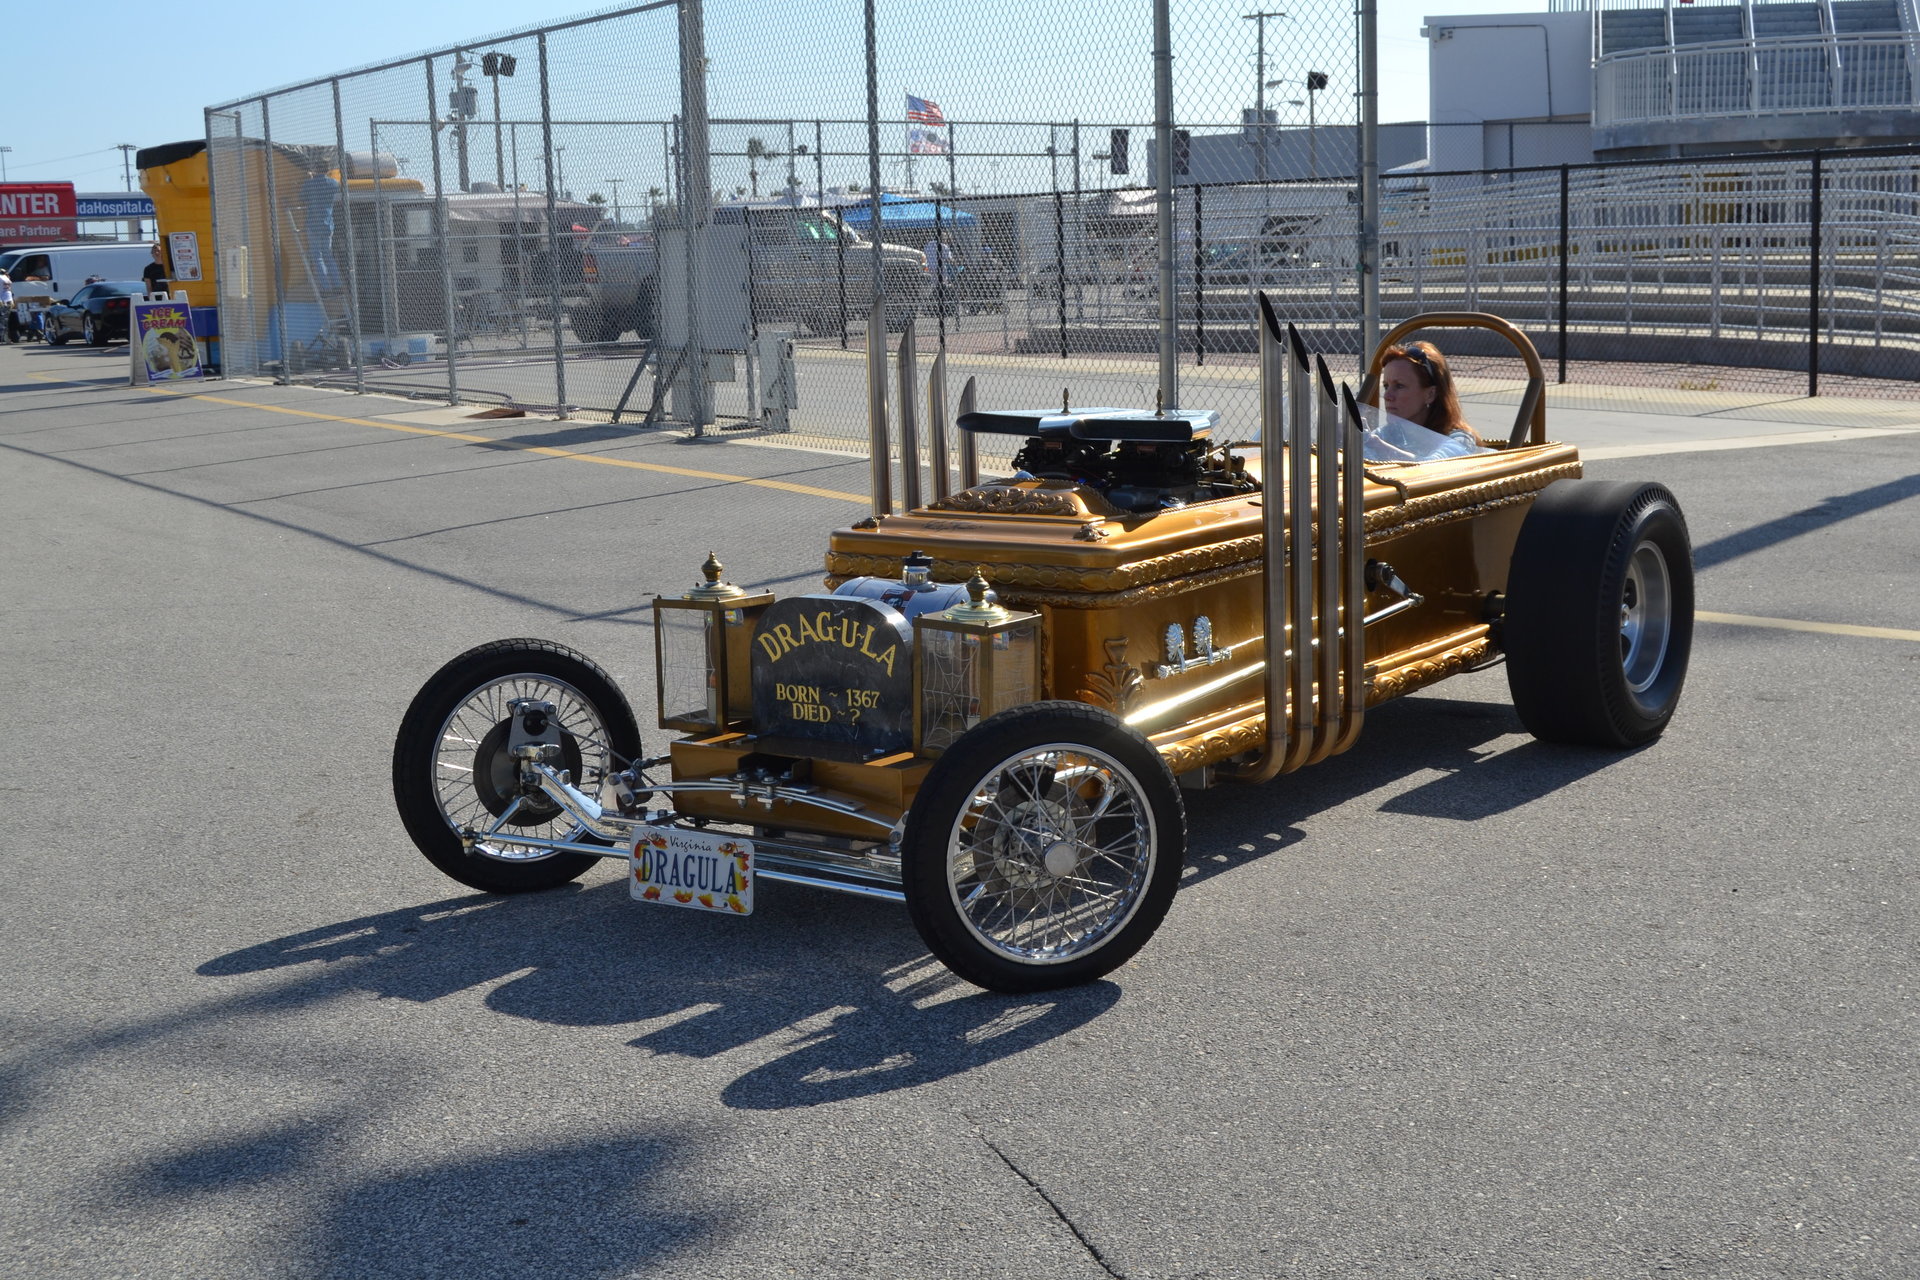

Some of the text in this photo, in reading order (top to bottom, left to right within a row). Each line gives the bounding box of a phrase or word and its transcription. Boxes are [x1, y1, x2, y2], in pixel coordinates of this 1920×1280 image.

[0, 193, 60, 214] NTER
[19, 225, 62, 236] Partner
[151, 308, 172, 318] ICE
[143, 319, 186, 330] CREAM
[776, 683, 820, 704] BORN
[846, 688, 881, 709] 1367
[792, 703, 831, 723] DIED
[849, 709, 861, 726] ?
[670, 836, 712, 852] Virginia
[641, 849, 738, 895] DRAGULA
